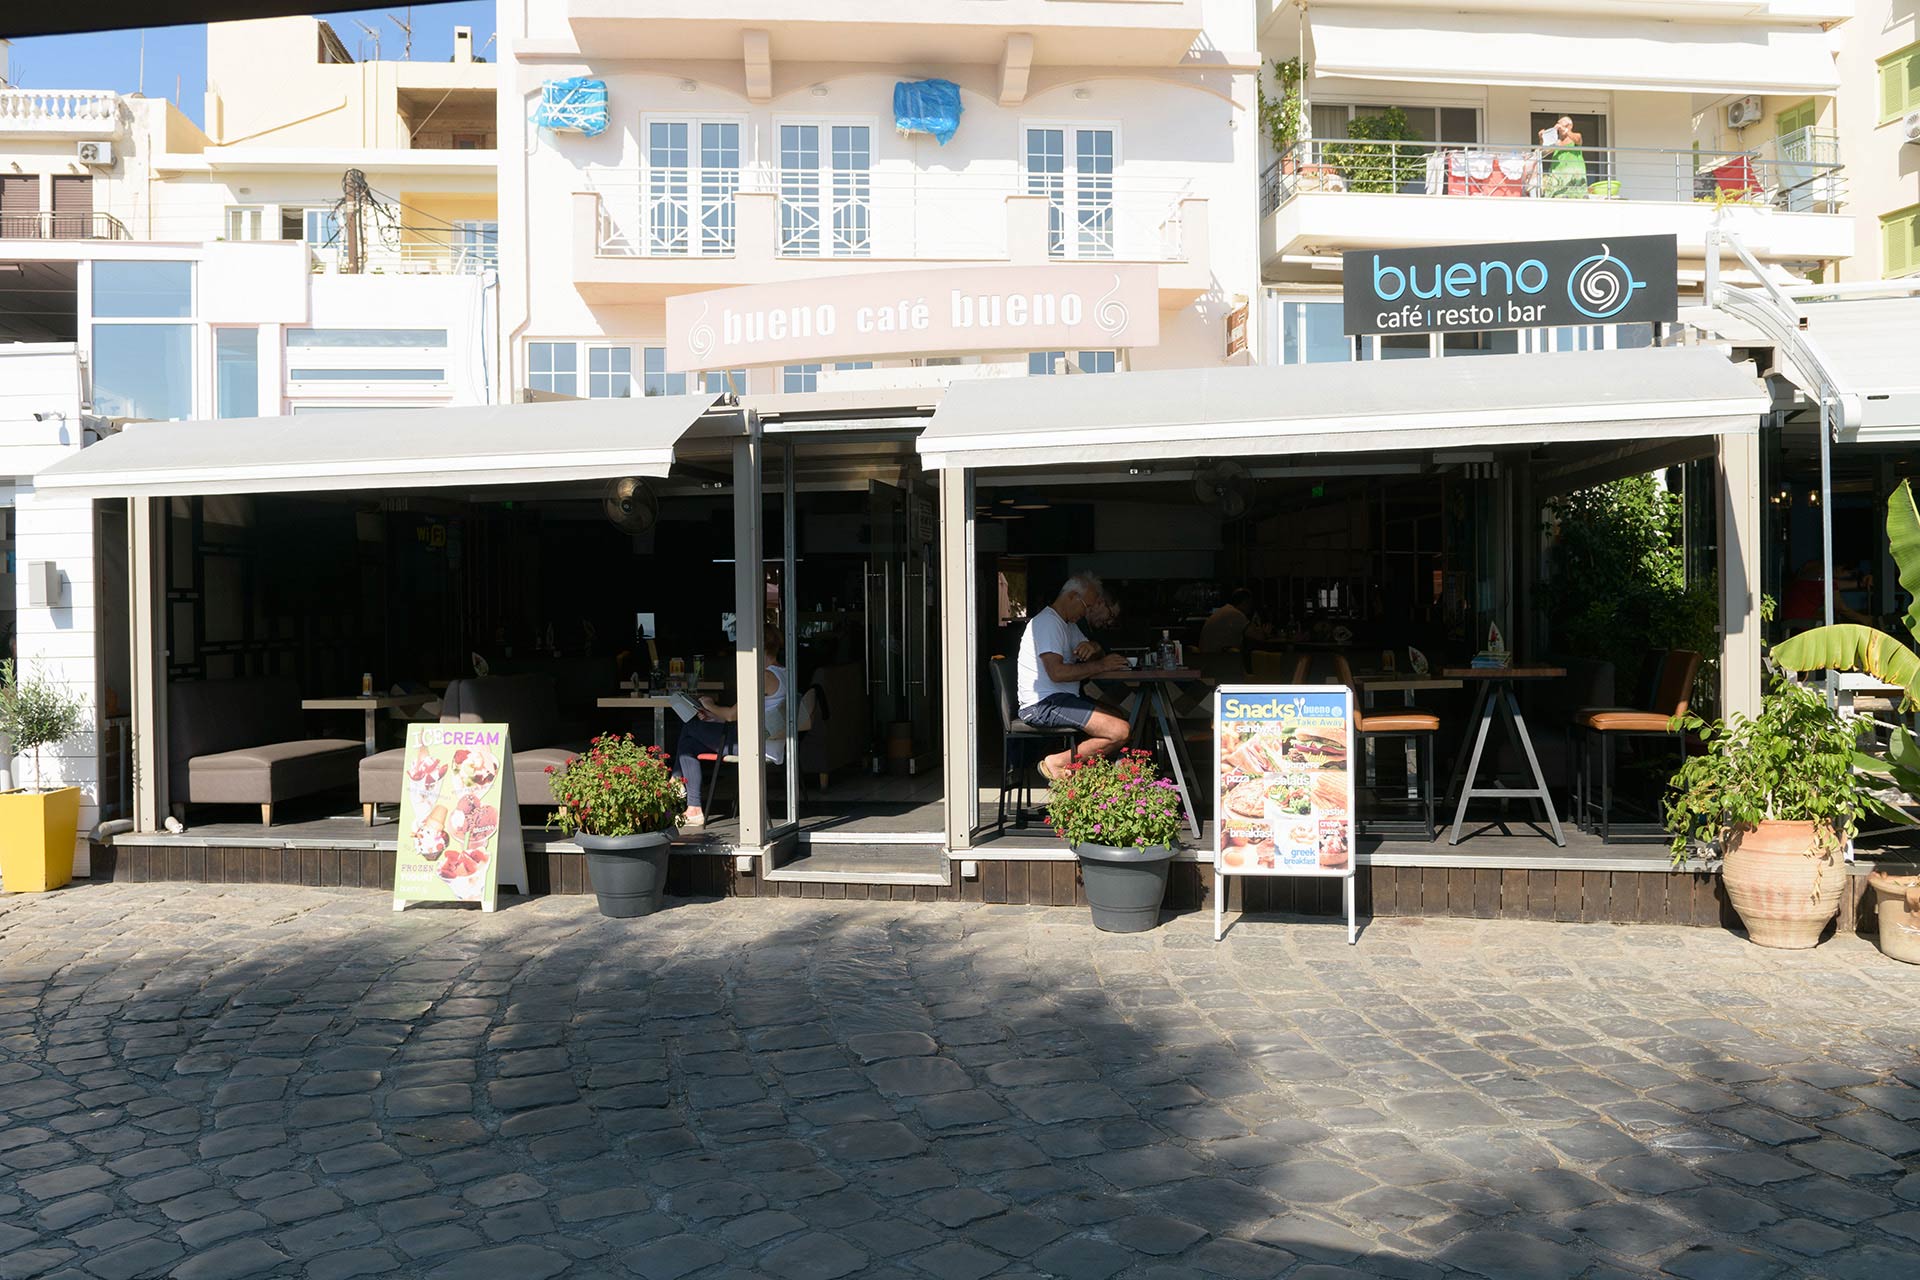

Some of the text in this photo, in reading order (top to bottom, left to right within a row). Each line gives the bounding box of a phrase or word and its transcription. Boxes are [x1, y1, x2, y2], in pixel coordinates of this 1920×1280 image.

[1373, 254, 1548, 301] bueno
[722, 289, 1082, 345] bueno café bueno
[1376, 301, 1547, 329] café resto bar
[1225, 699, 1294, 719] Snacks
[1303, 705, 1331, 714] bueno
[1320, 719, 1343, 727] Away
[412, 728, 499, 748] ICE CREAM
[1284, 857, 1316, 865] breakfast
[1291, 848, 1316, 859] greek
[401, 864, 434, 873] FROZEN
